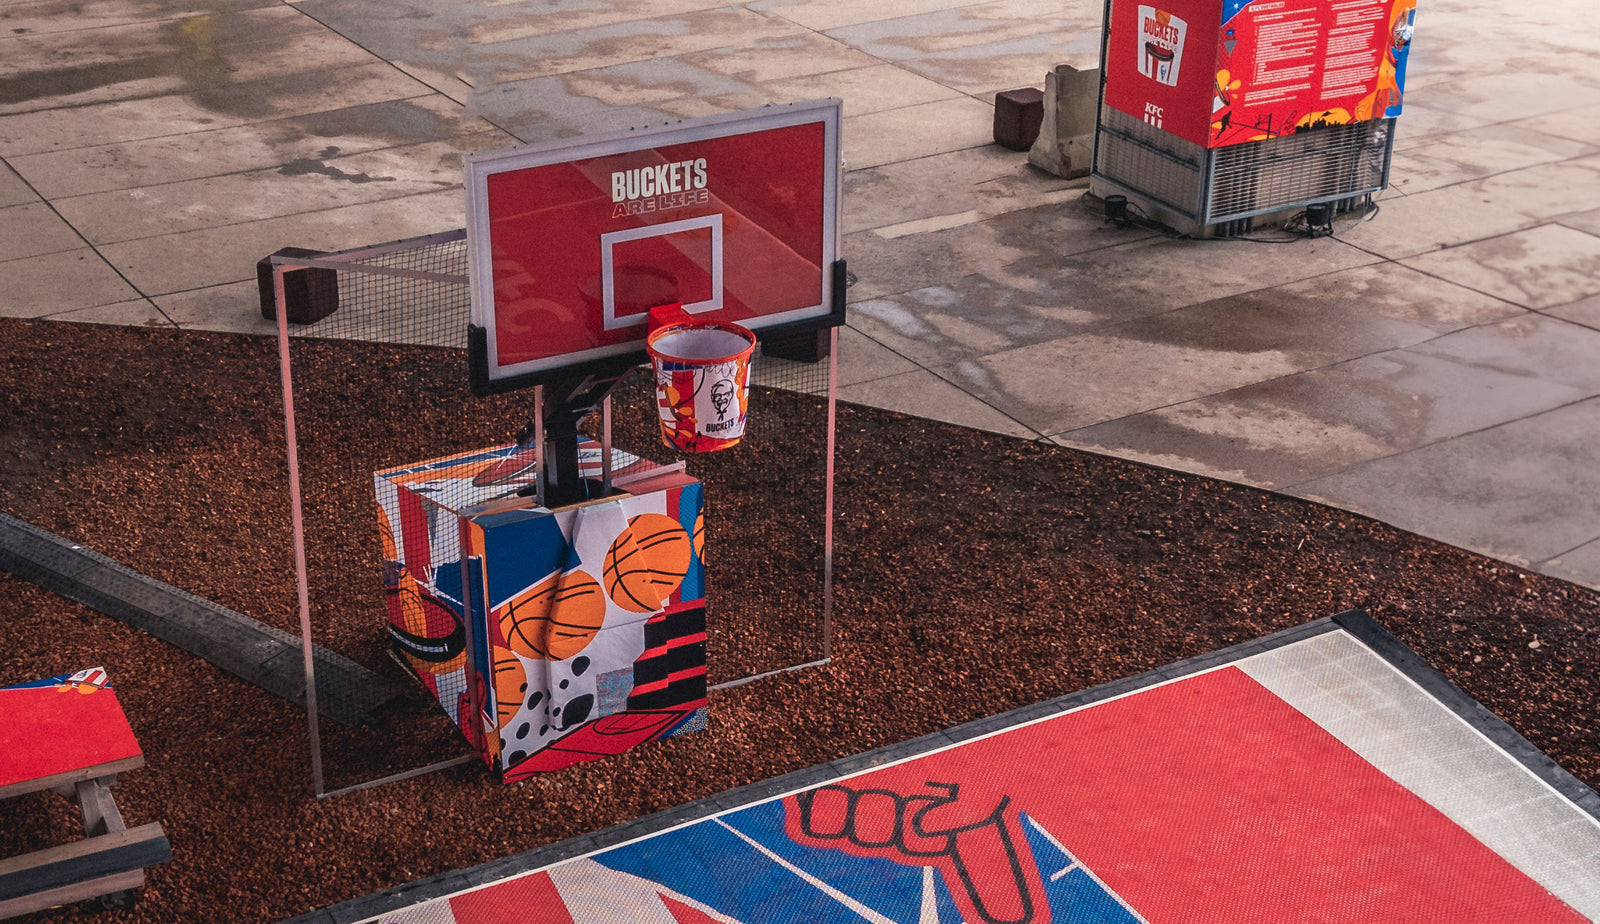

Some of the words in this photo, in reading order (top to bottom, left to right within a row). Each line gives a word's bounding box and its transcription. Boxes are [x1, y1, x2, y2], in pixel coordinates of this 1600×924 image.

[1144, 17, 1179, 45] BUCKETS
[1145, 102, 1164, 118] KFC
[611, 158, 708, 203] BUCKETS
[612, 197, 656, 219] ARE
[659, 188, 709, 211] LIFE
[706, 418, 735, 433] BUCKETS
